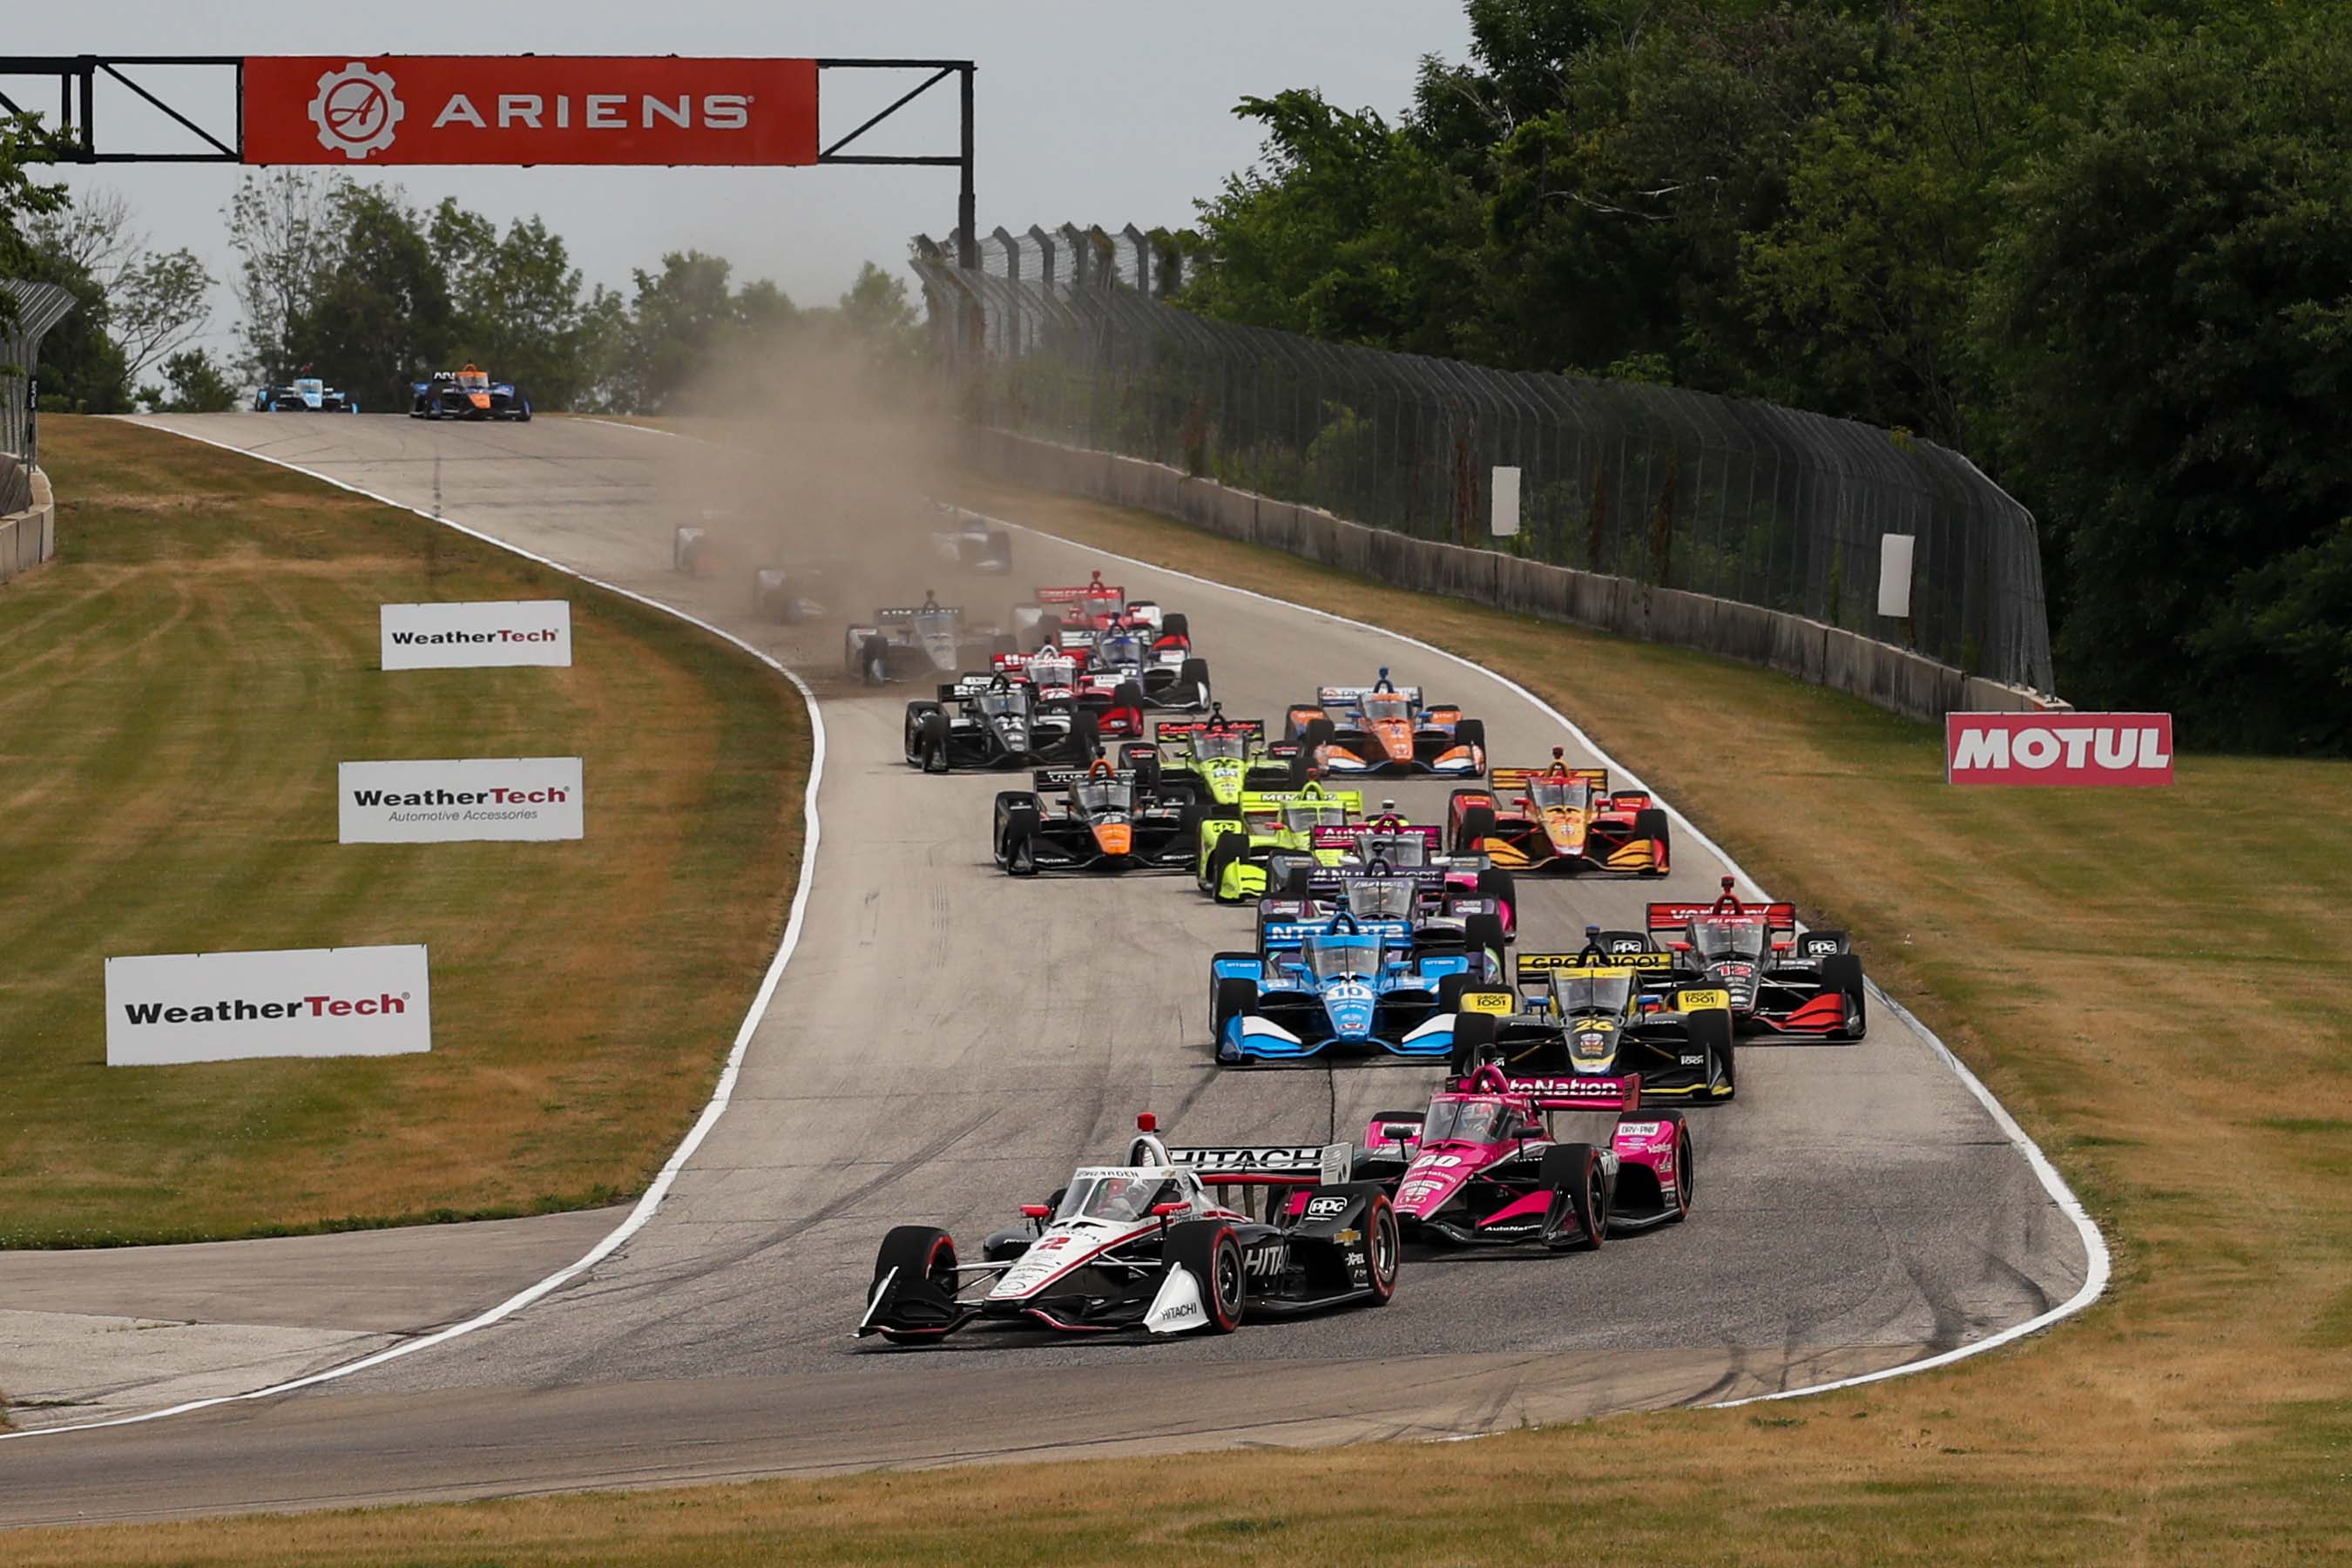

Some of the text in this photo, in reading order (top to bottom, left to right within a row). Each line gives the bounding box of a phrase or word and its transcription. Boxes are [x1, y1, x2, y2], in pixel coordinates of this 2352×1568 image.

[432, 93, 748, 129] ARIENS
[391, 629, 556, 645] WeatherTech
[1952, 727, 2170, 770] MOTUL
[354, 787, 566, 807] WeatherTech
[389, 808, 537, 822] Automotive Accessories
[1323, 828, 1426, 839] AutoNaton
[1717, 965, 1752, 977] 12
[1335, 987, 1363, 997] 10
[125, 994, 406, 1025] WeatherTech
[1572, 1018, 1614, 1032] 26
[1480, 1079, 1618, 1096] AtoNation
[1170, 1149, 1322, 1170] HITACH
[1311, 1200, 1344, 1213] PPG
[1037, 1236, 1071, 1251] 2
[1161, 1302, 1198, 1321] HITACHI
